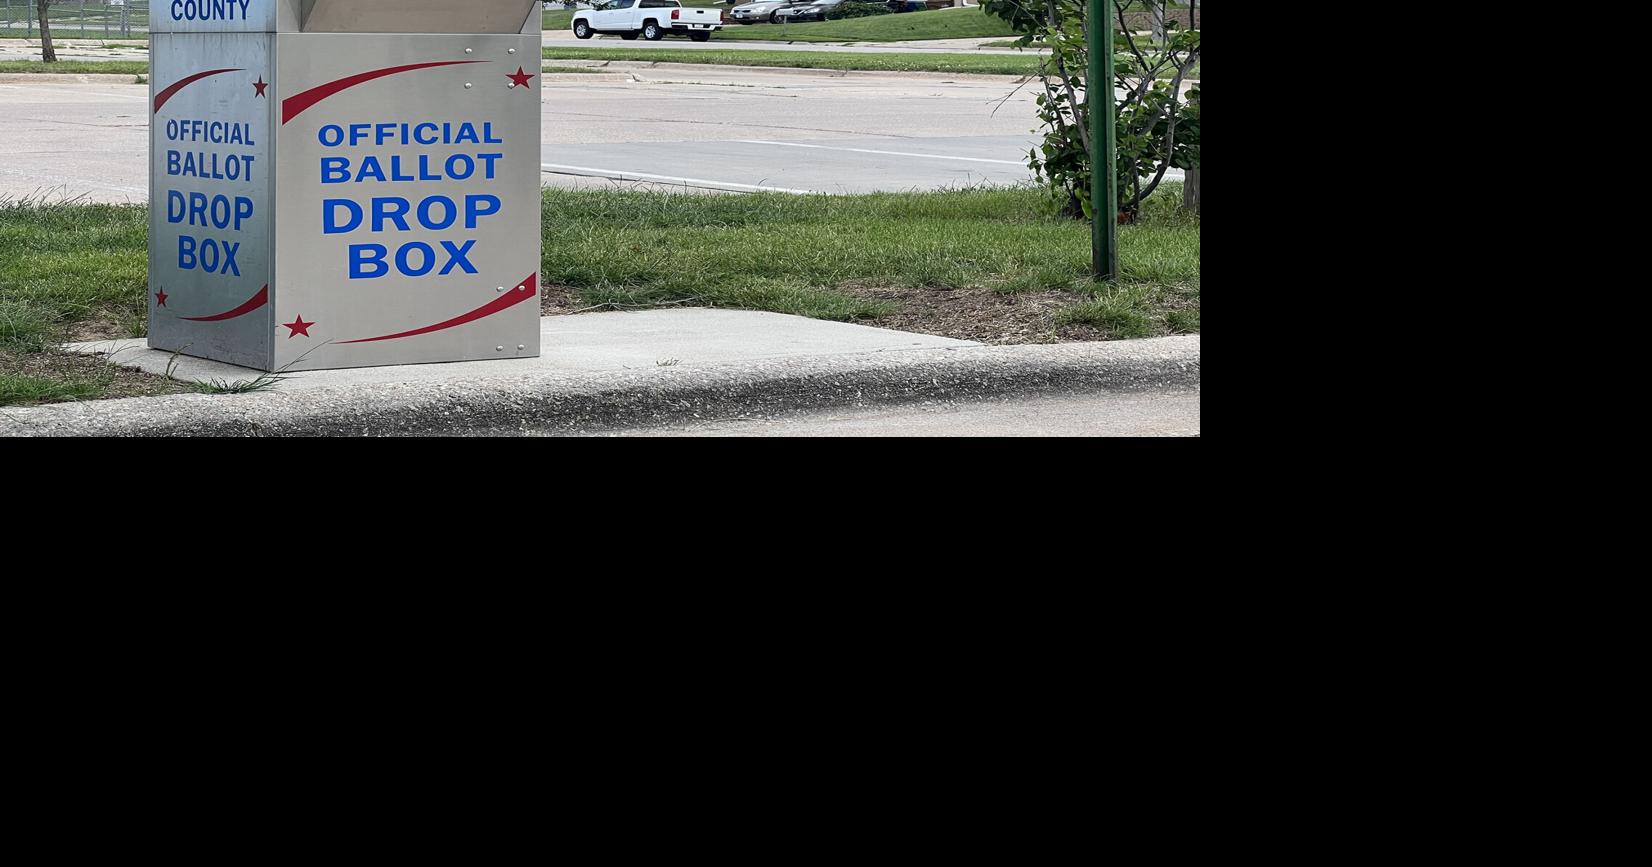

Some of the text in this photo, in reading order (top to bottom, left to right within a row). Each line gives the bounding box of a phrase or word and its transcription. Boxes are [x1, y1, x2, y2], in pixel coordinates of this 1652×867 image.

[170, 0, 251, 21] COUNTY
[166, 119, 255, 146] OFFICIAL
[316, 122, 504, 147] OFFICIAL
[167, 150, 255, 181] BALLOT
[319, 152, 503, 184] BALLOT
[167, 190, 254, 231] DROP
[322, 195, 502, 235] DROP
[178, 235, 241, 277] BOX
[348, 239, 478, 280] BOX
